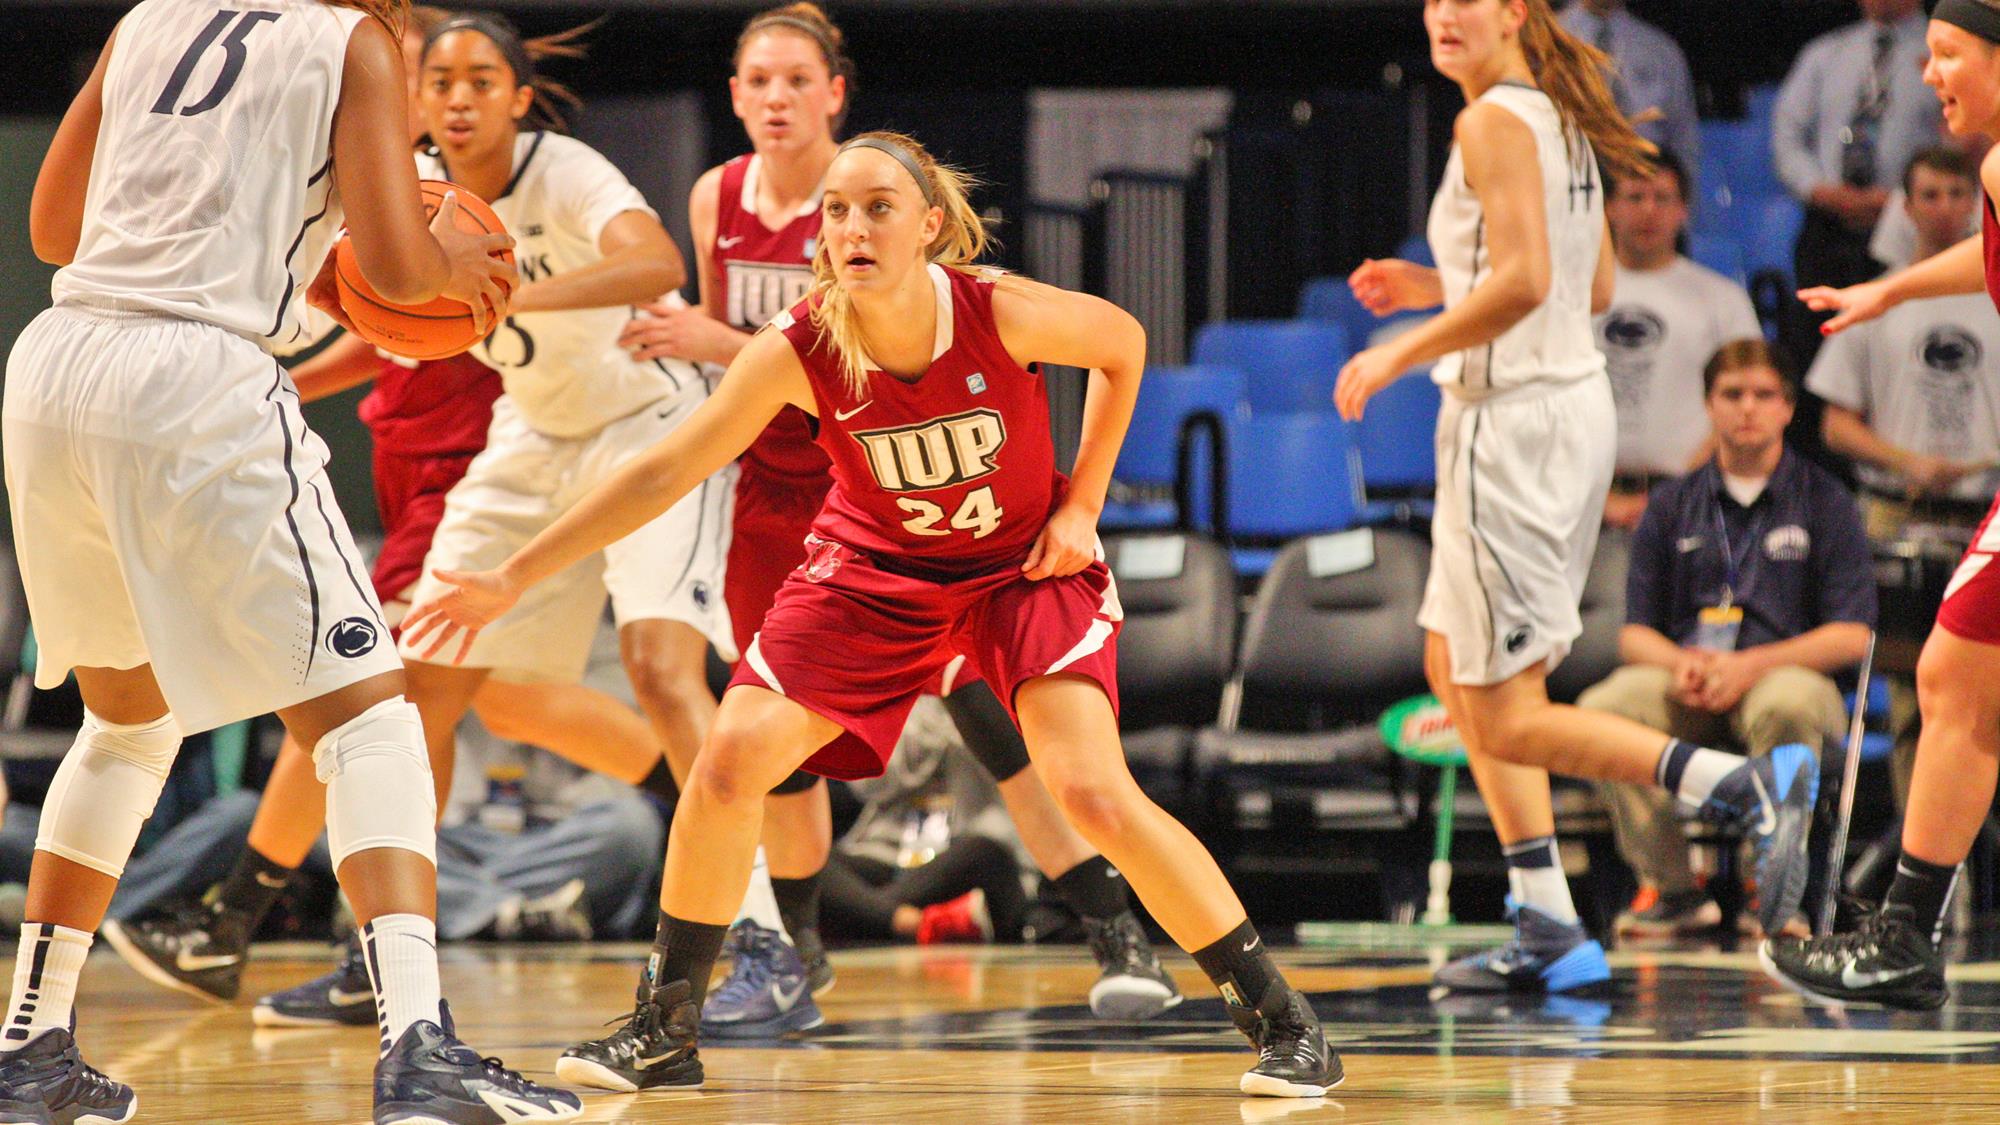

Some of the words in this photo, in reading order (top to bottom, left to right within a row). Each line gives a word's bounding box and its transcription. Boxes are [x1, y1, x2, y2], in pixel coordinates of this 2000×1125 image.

[149, 9, 283, 117] 15
[850, 407, 1007, 492] IUP
[895, 485, 1004, 540] 24
